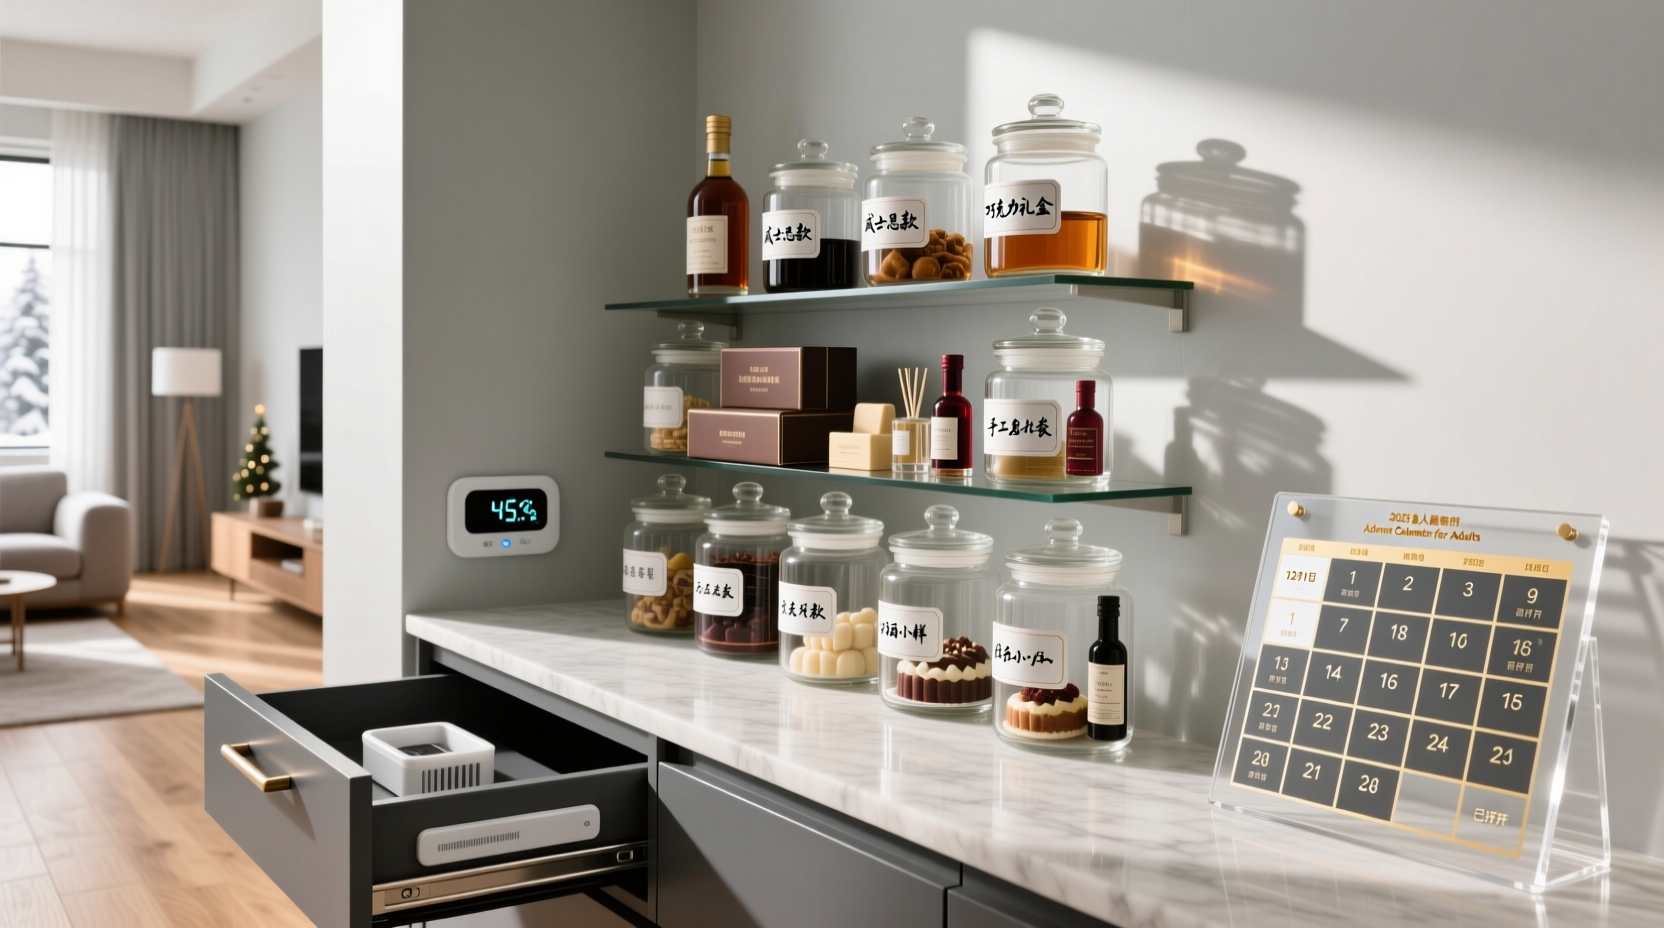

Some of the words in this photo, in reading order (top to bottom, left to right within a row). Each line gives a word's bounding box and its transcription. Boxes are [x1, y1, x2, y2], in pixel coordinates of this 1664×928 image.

[1349, 570, 1357, 585] 1
[1402, 575, 1414, 591] 2
[1462, 581, 1474, 597] 3
[1526, 587, 1539, 604] 9
[1339, 618, 1350, 633] 7
[1391, 624, 1408, 641] 18
[1274, 655, 1290, 671] 13
[1325, 664, 1342, 682] 14
[1380, 672, 1398, 690] 16
[1440, 682, 1460, 700] 17
[1312, 712, 1333, 731] 22
[1367, 722, 1389, 741] 23
[1426, 733, 1449, 753] 24
[1302, 762, 1321, 781] 21
